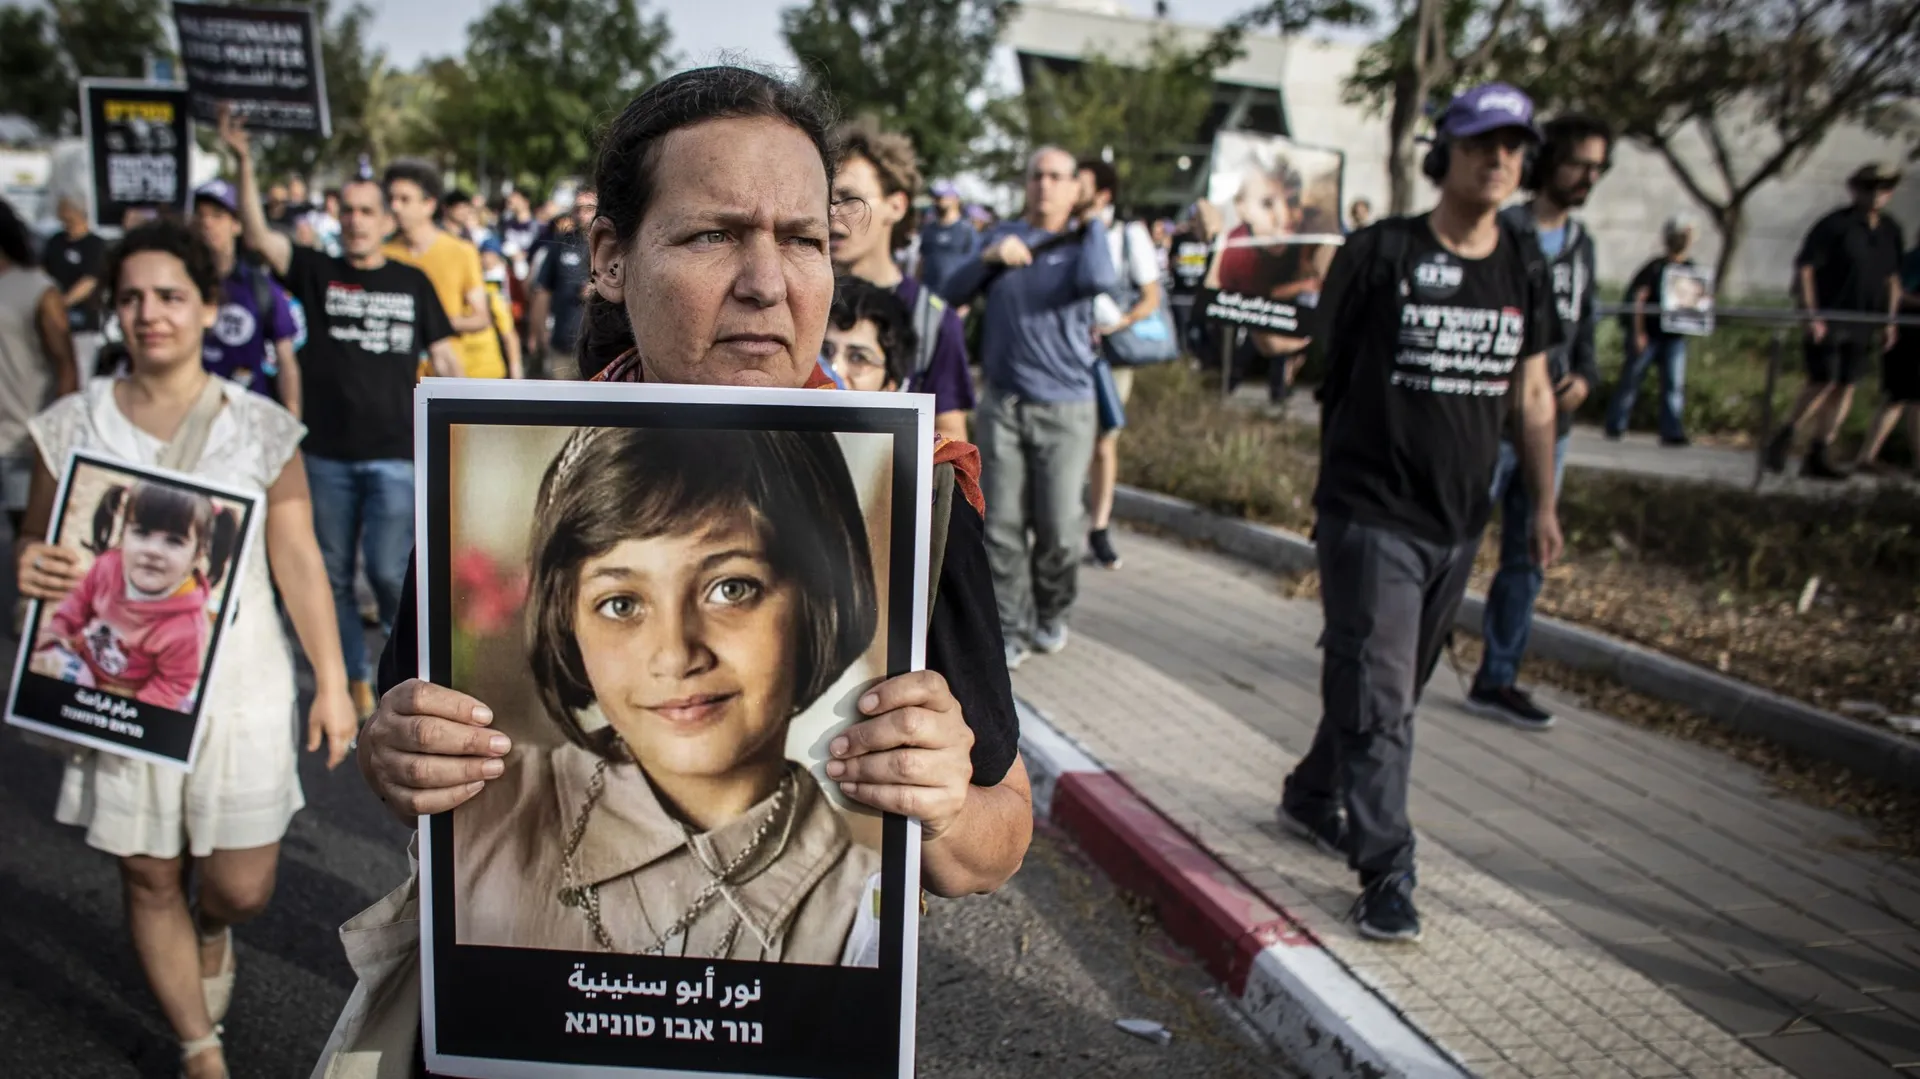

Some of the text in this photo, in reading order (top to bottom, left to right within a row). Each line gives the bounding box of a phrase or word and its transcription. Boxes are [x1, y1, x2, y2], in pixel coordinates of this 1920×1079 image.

[567, 962, 762, 1009] نور أبو سنينية
[564, 1011, 764, 1044] נור אבו סונינא
